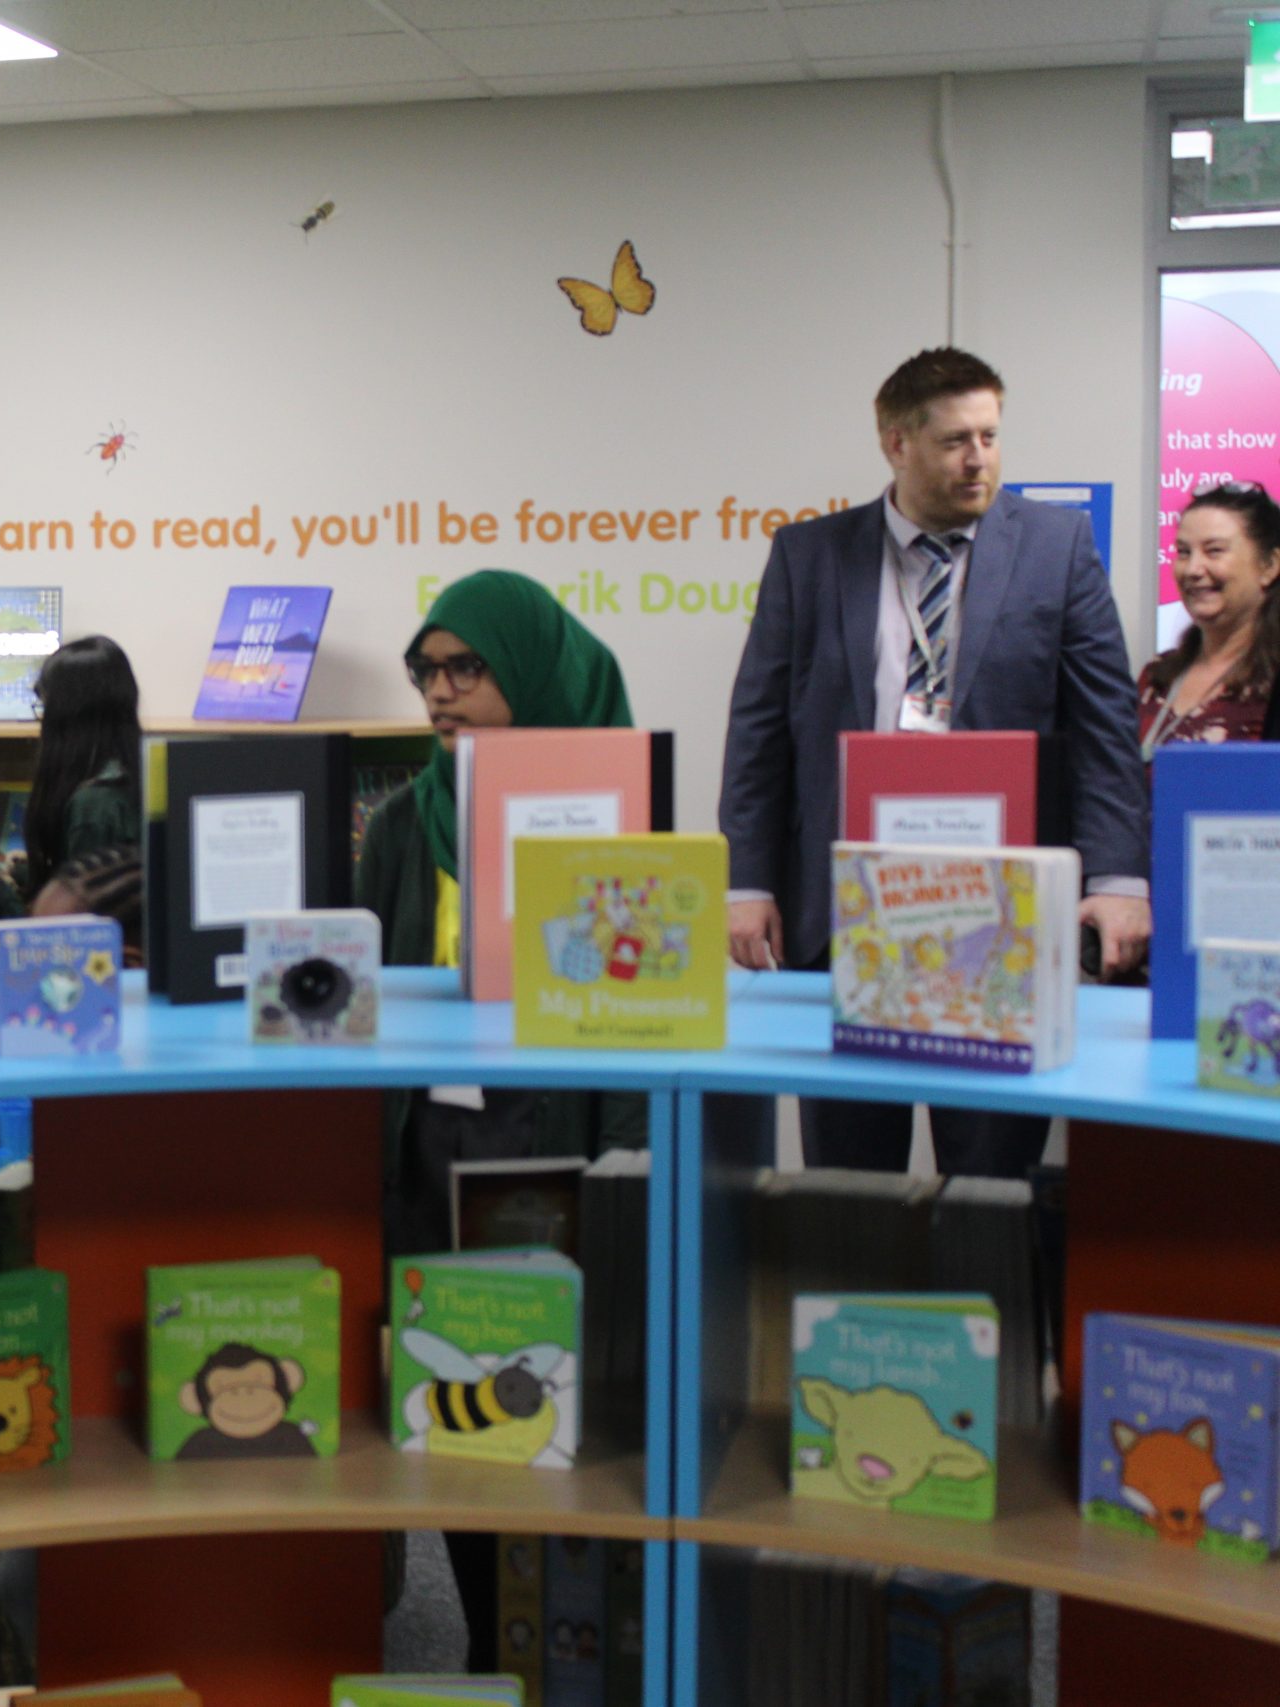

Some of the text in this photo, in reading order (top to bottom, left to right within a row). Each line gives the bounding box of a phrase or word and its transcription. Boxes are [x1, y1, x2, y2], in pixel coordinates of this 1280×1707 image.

[1167, 428, 1276, 450] that show
[90, 511, 137, 550] to
[152, 504, 277, 556] read,
[291, 501, 420, 559] you'll
[437, 500, 499, 545] be
[514, 499, 701, 544] forever
